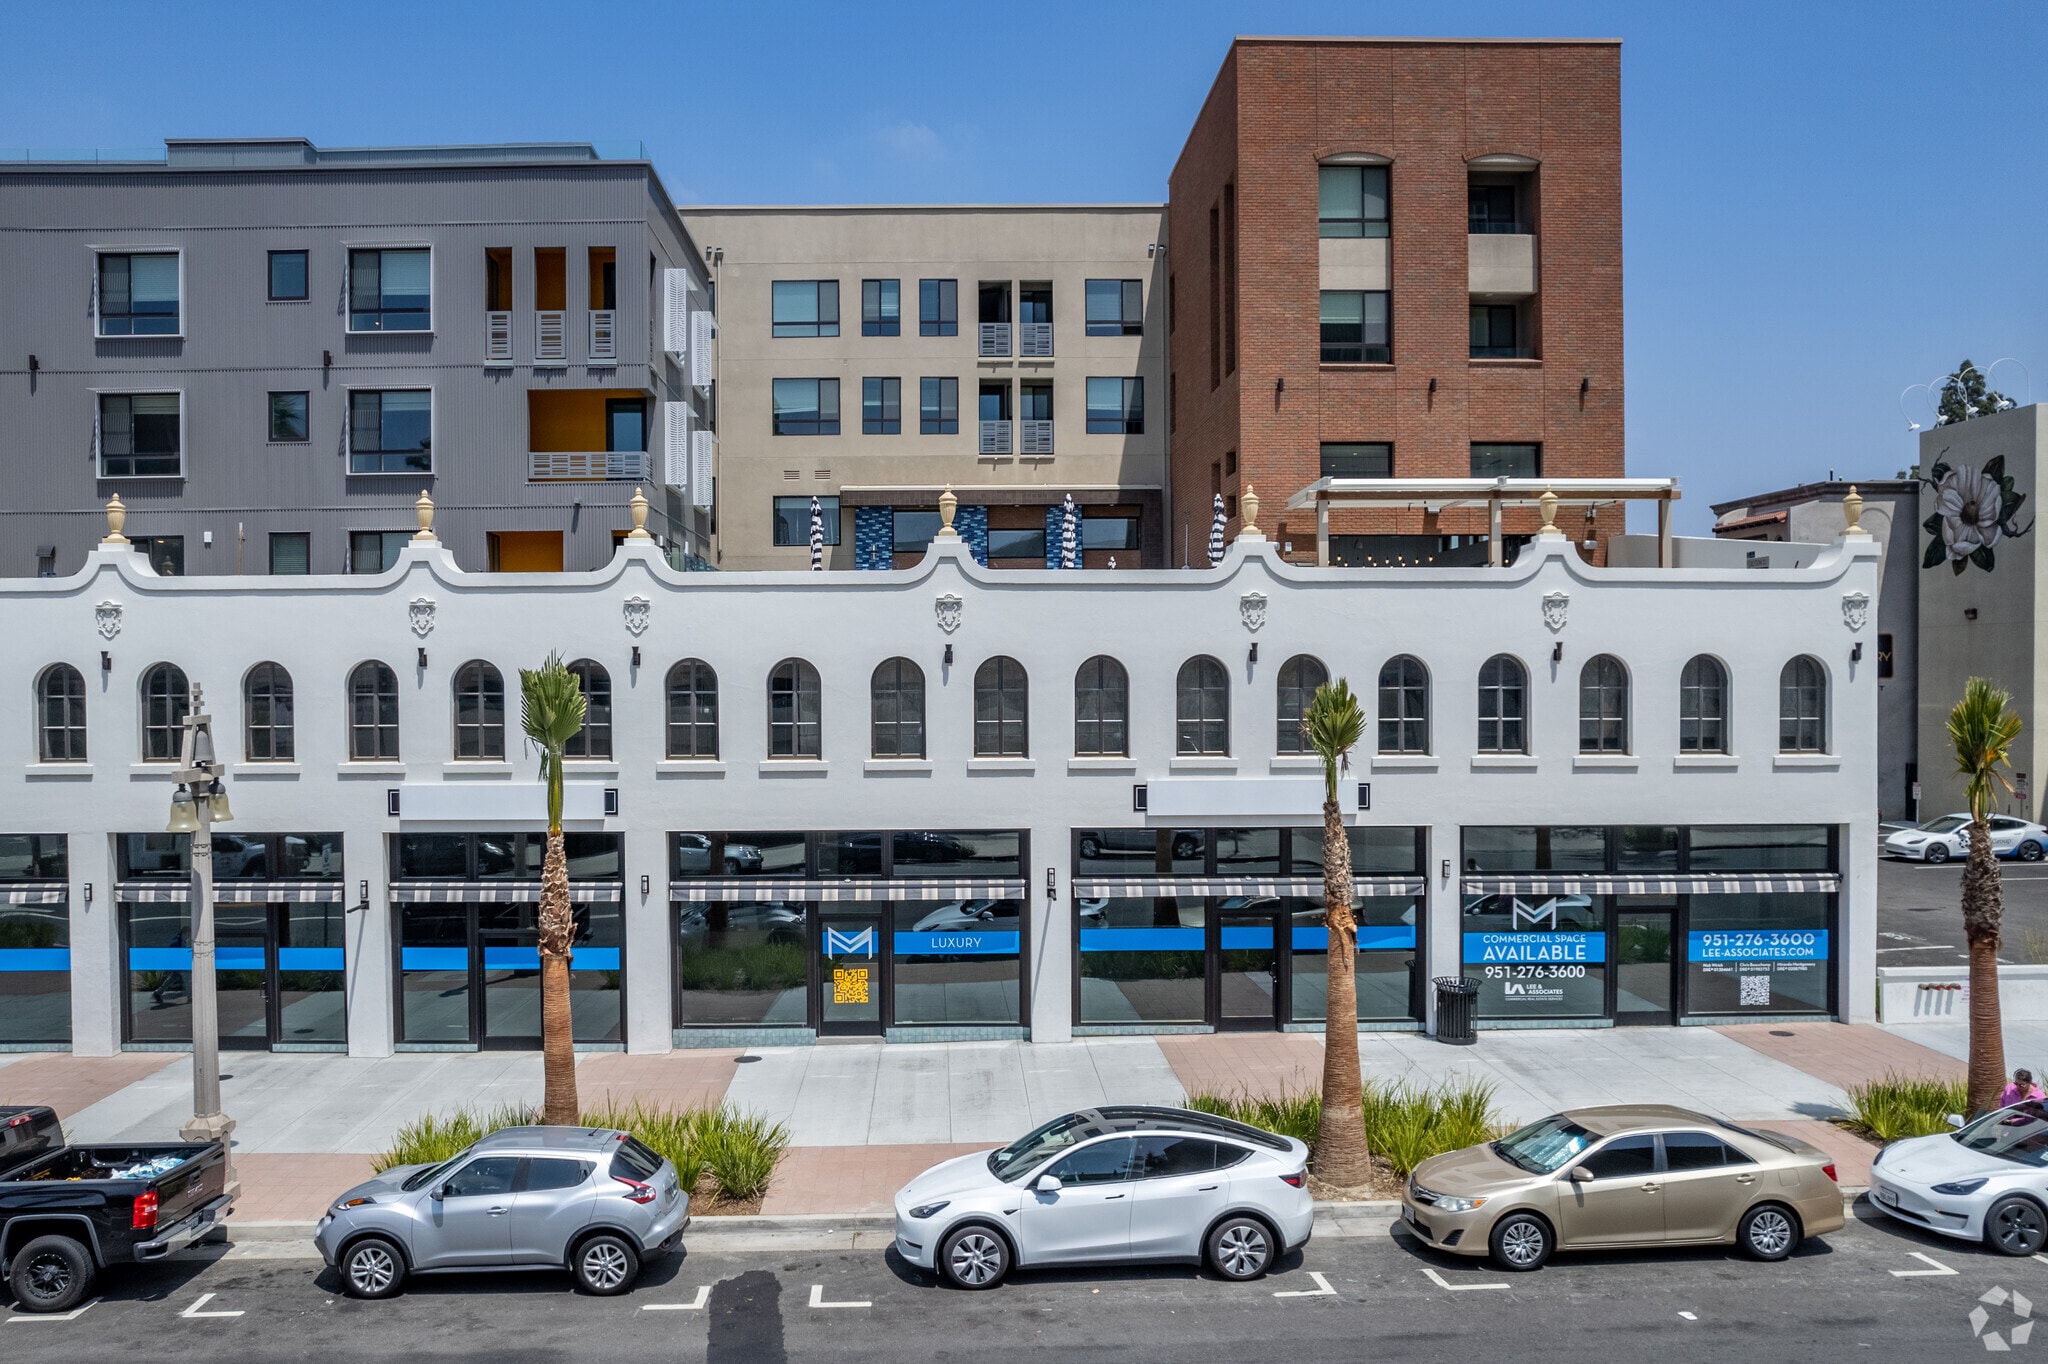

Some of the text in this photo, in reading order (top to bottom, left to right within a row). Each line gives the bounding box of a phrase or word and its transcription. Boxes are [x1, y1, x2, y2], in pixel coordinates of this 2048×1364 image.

[931, 937, 982, 948] LUXURY
[1483, 934, 1586, 943] COMMERCIAL SPACE
[1702, 932, 1815, 947] 951-276-3600
[1483, 945, 1586, 960] AVAILABLE
[1702, 947, 1814, 957] LEE-ASSOCIATES.COM
[1485, 965, 1586, 979] 951-276-3600
